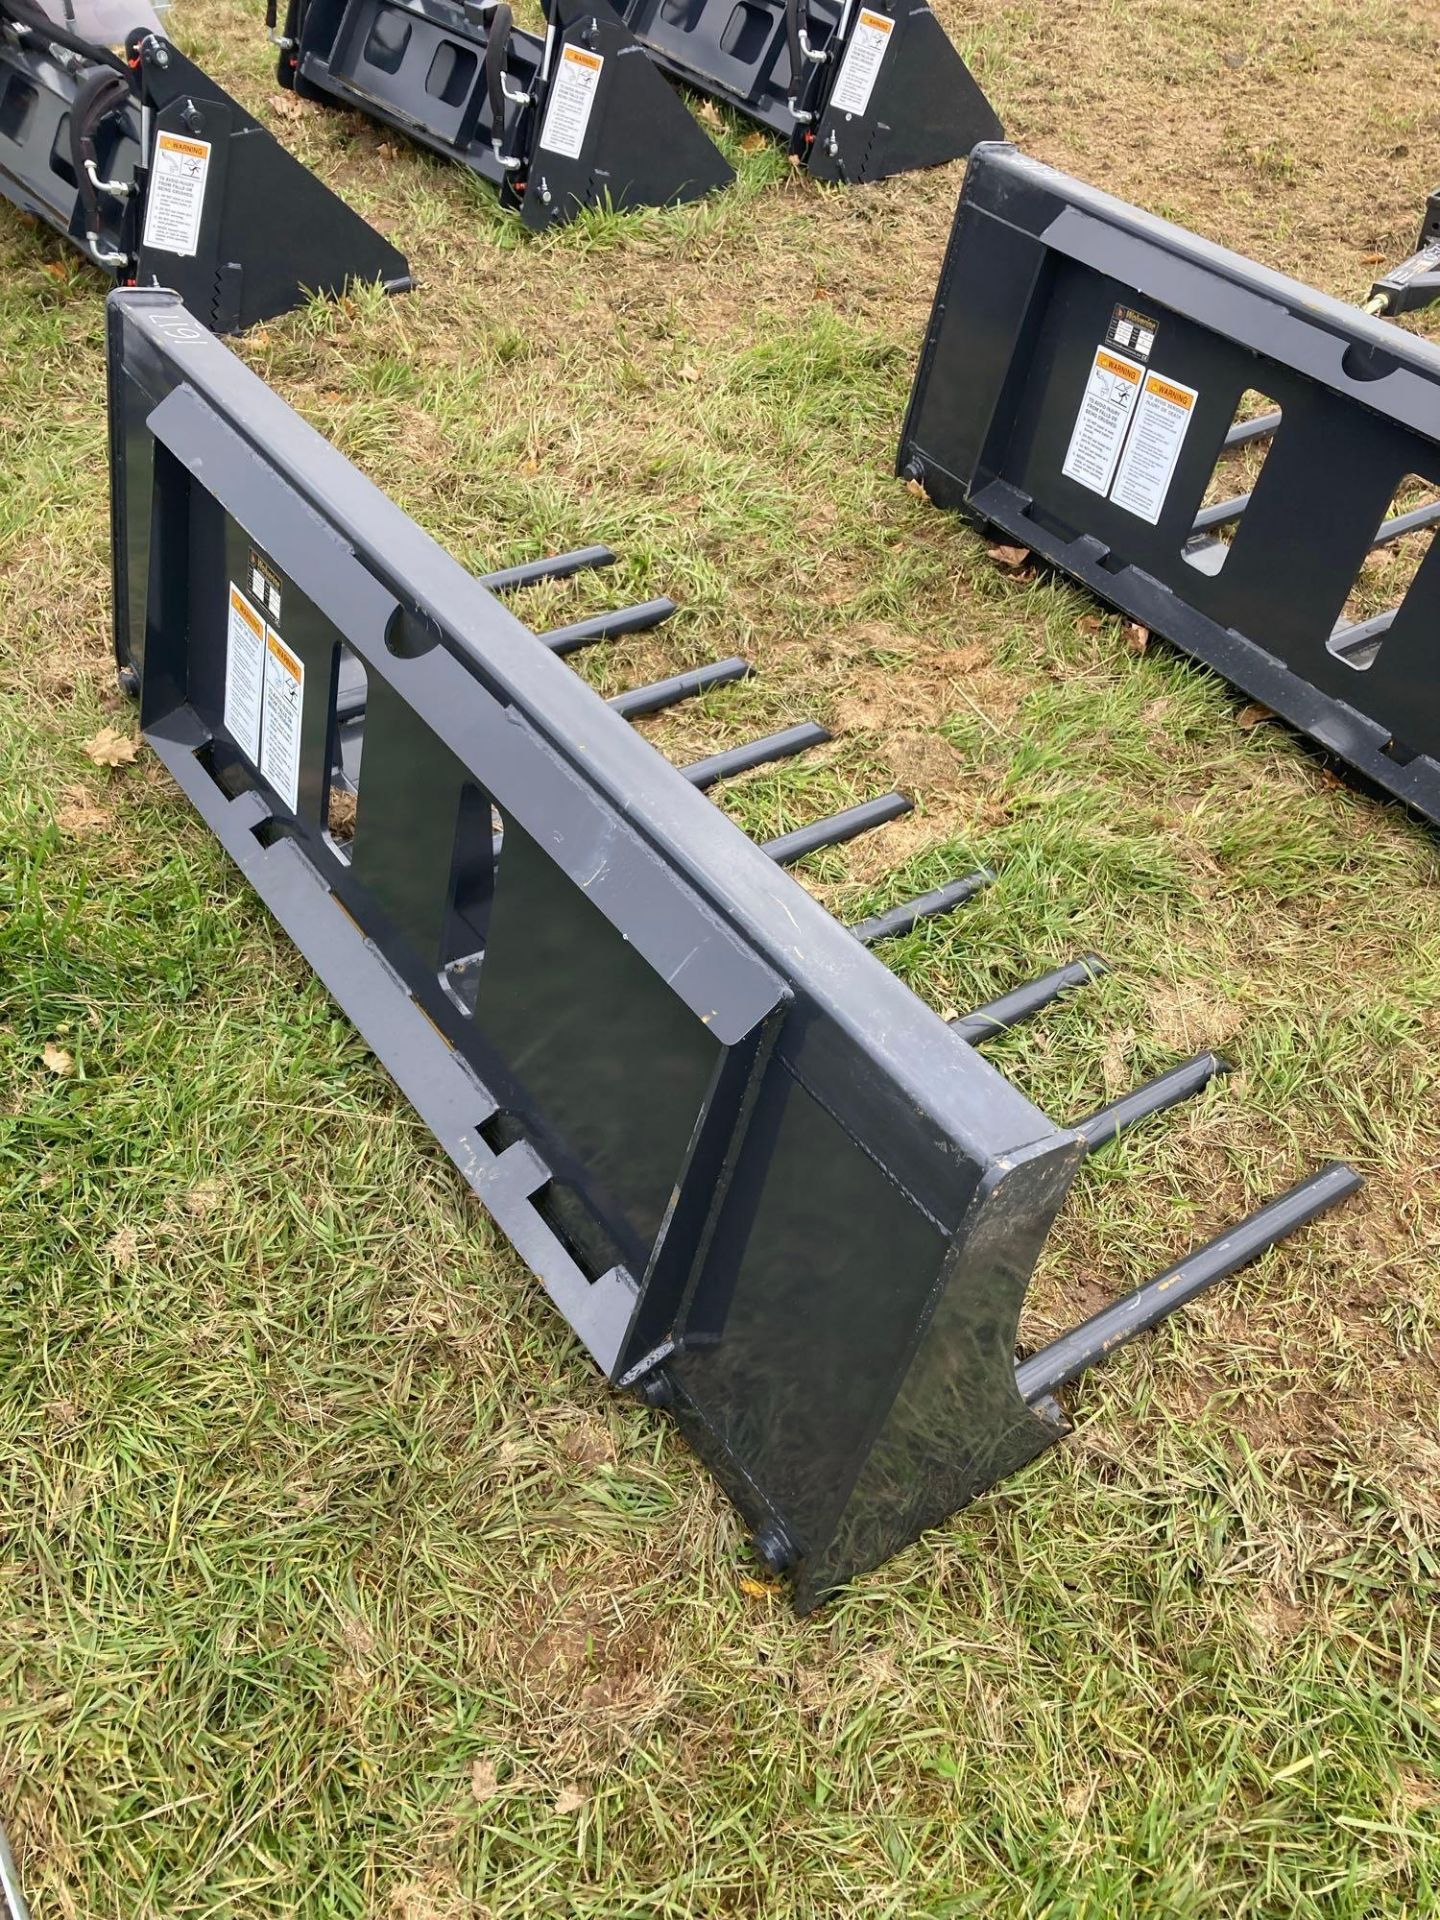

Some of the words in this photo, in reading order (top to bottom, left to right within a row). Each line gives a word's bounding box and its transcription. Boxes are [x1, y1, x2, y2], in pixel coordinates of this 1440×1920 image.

[173, 143, 203, 155] WARNING
[1108, 360, 1136, 380] WARNING
[1159, 384, 1188, 405] WARNING
